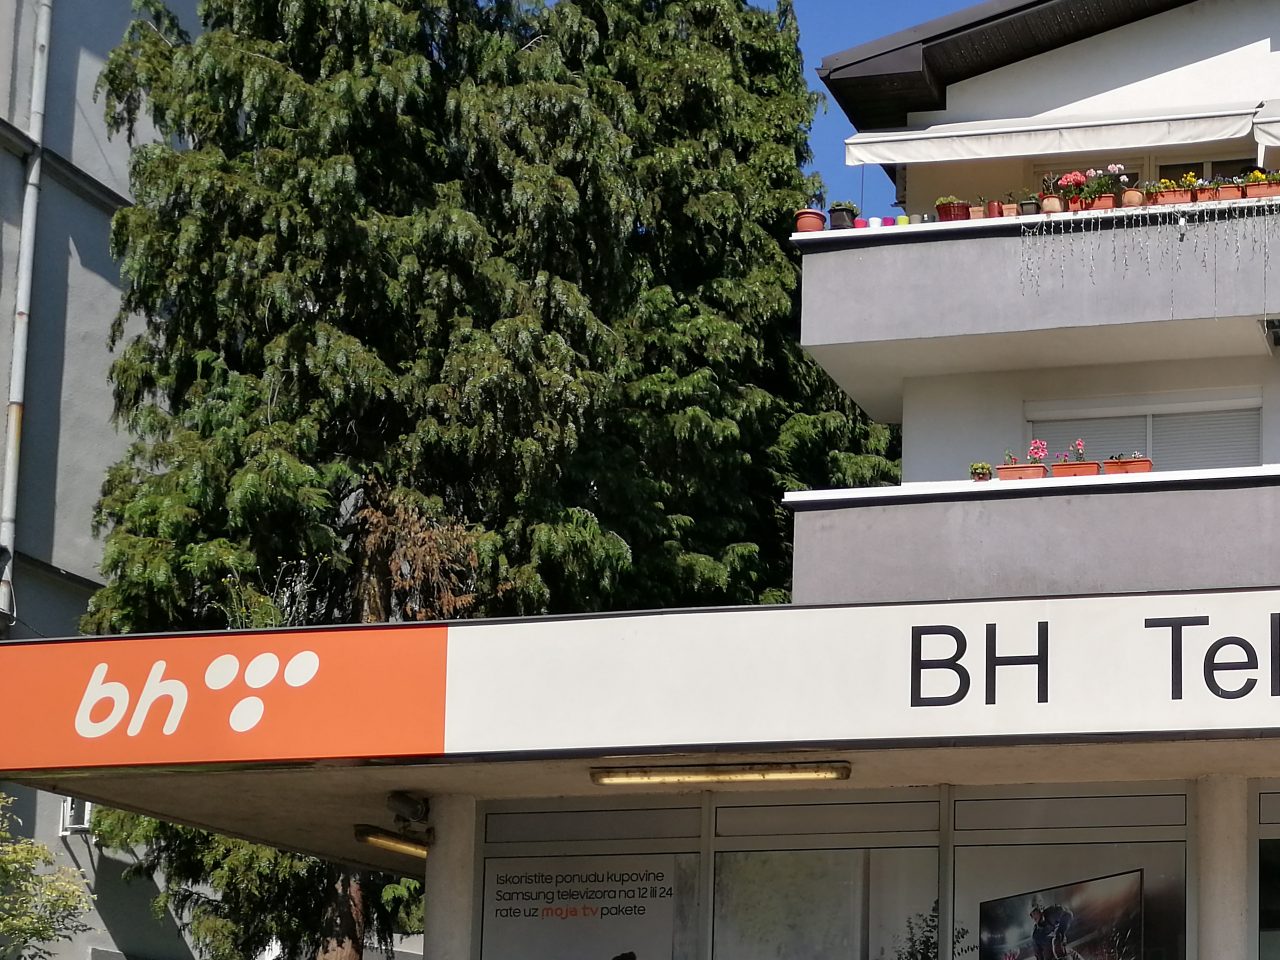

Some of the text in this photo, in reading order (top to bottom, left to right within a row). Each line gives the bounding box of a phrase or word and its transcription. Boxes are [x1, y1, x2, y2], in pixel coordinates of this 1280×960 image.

[910, 621, 1049, 707] BH
[74, 659, 188, 738] bh
[496, 870, 665, 887] Iskoristite ponudu kupovine
[495, 886, 674, 904] Samsung televizora na 12 ili 24
[495, 903, 646, 919] rate uz moja tv pakete
